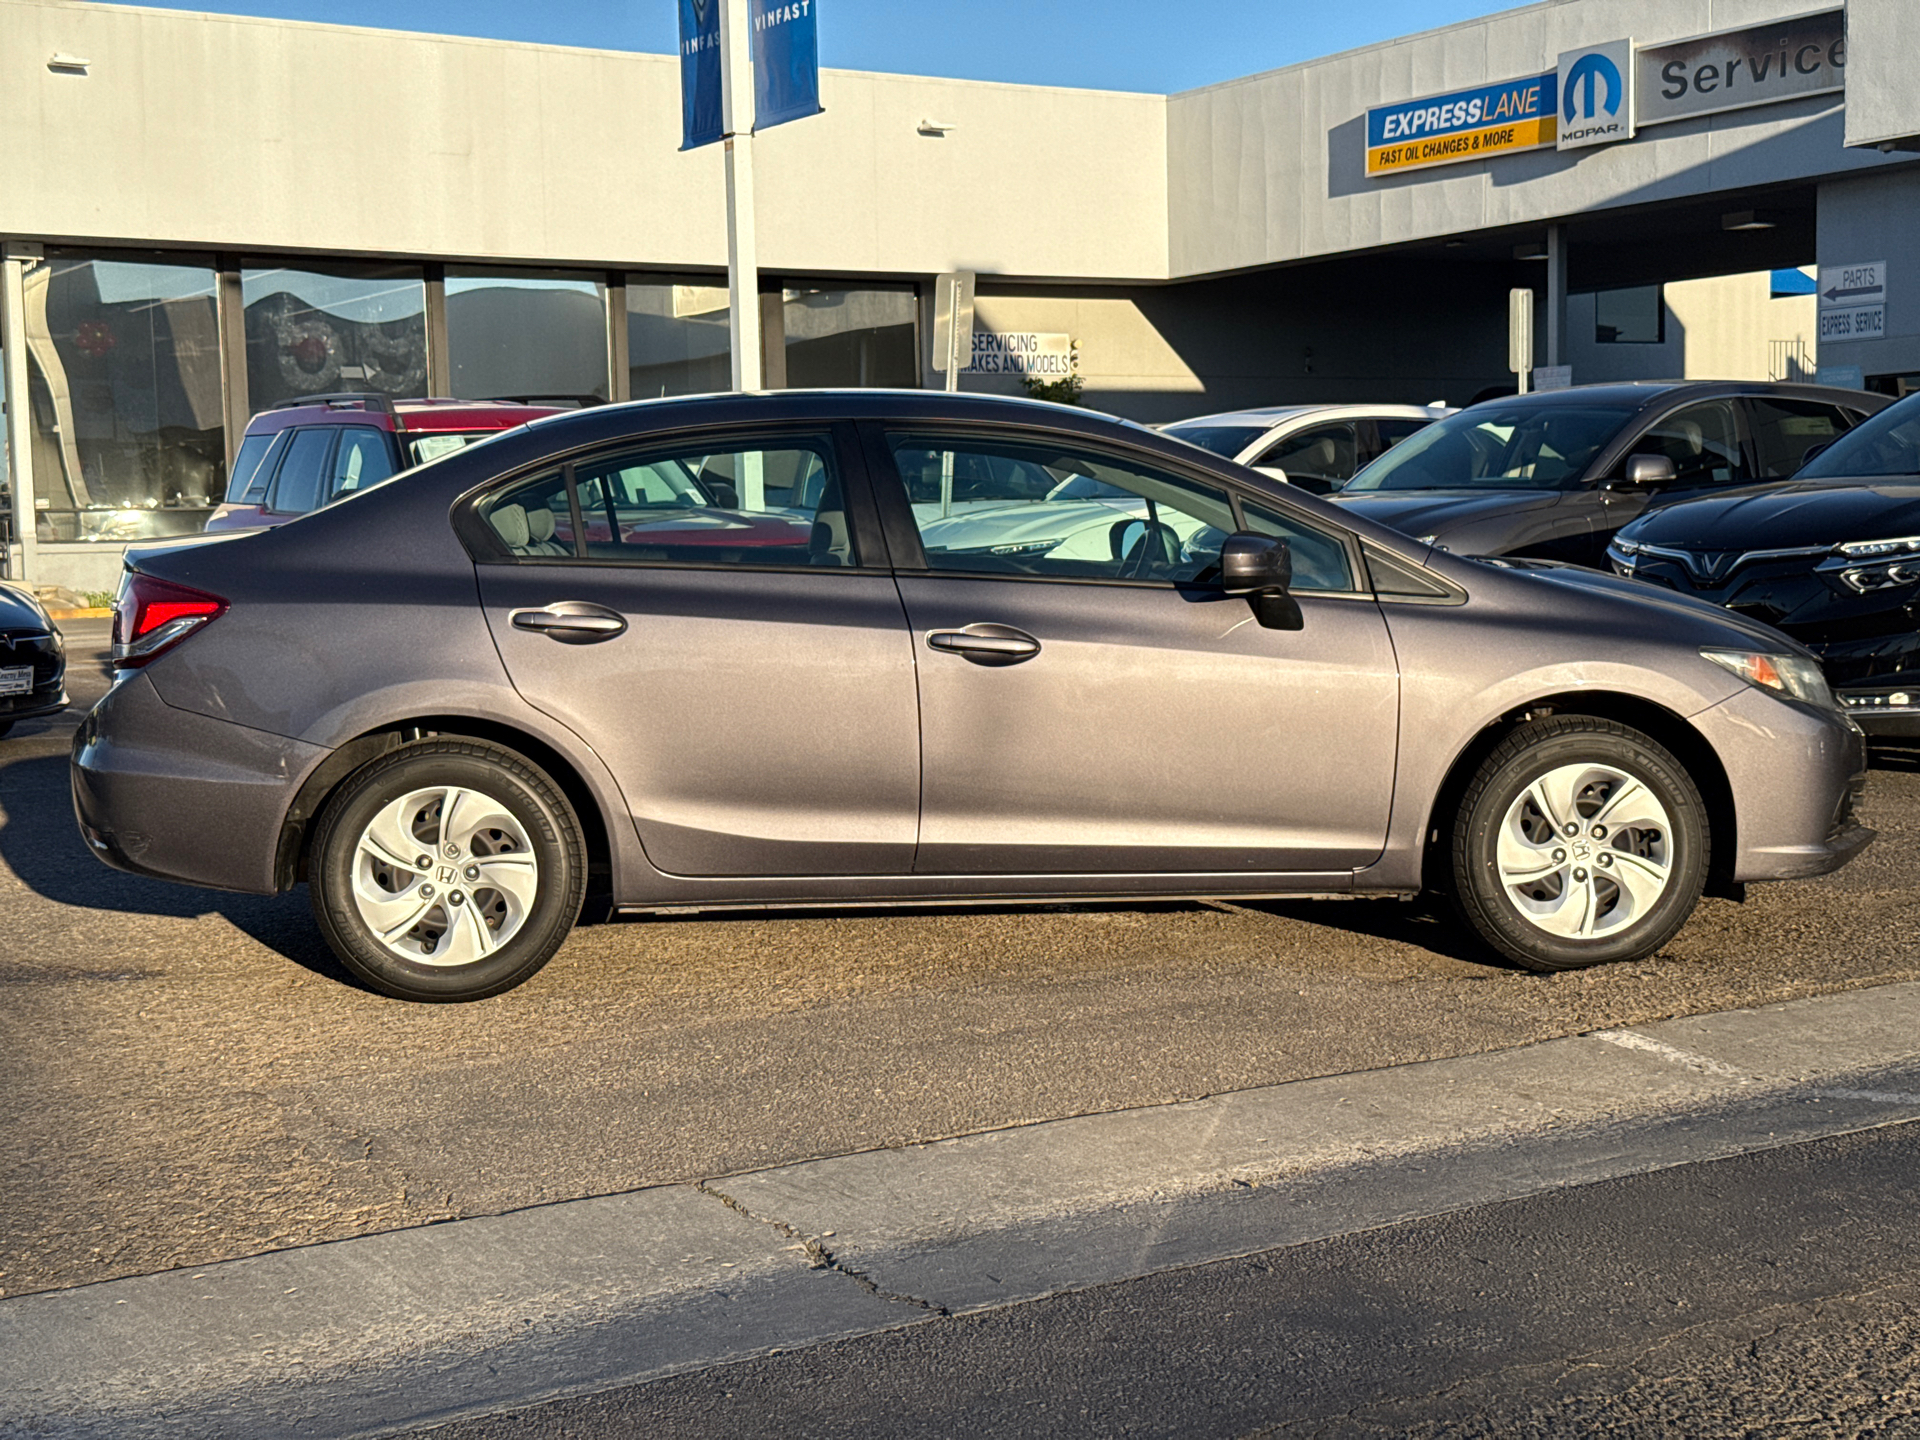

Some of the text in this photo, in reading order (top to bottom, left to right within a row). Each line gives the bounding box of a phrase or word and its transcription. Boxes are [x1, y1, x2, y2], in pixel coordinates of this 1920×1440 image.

[754, 2, 810, 32] VINFAST
[1661, 37, 1844, 100] Service
[1561, 123, 1619, 142] MOPAR
[1379, 128, 1514, 166] FAST OIL CHANGES & MORE
[1842, 267, 1875, 288] PARTS
[1822, 310, 1882, 336] EXPRESS SERVICE
[971, 334, 1038, 352] SERVICING
[1002, 355, 1024, 374] AND
[1026, 354, 1068, 374] MODELS
[1636, 754, 1685, 804] MICHELIN
[508, 785, 555, 841] MICHELIN
